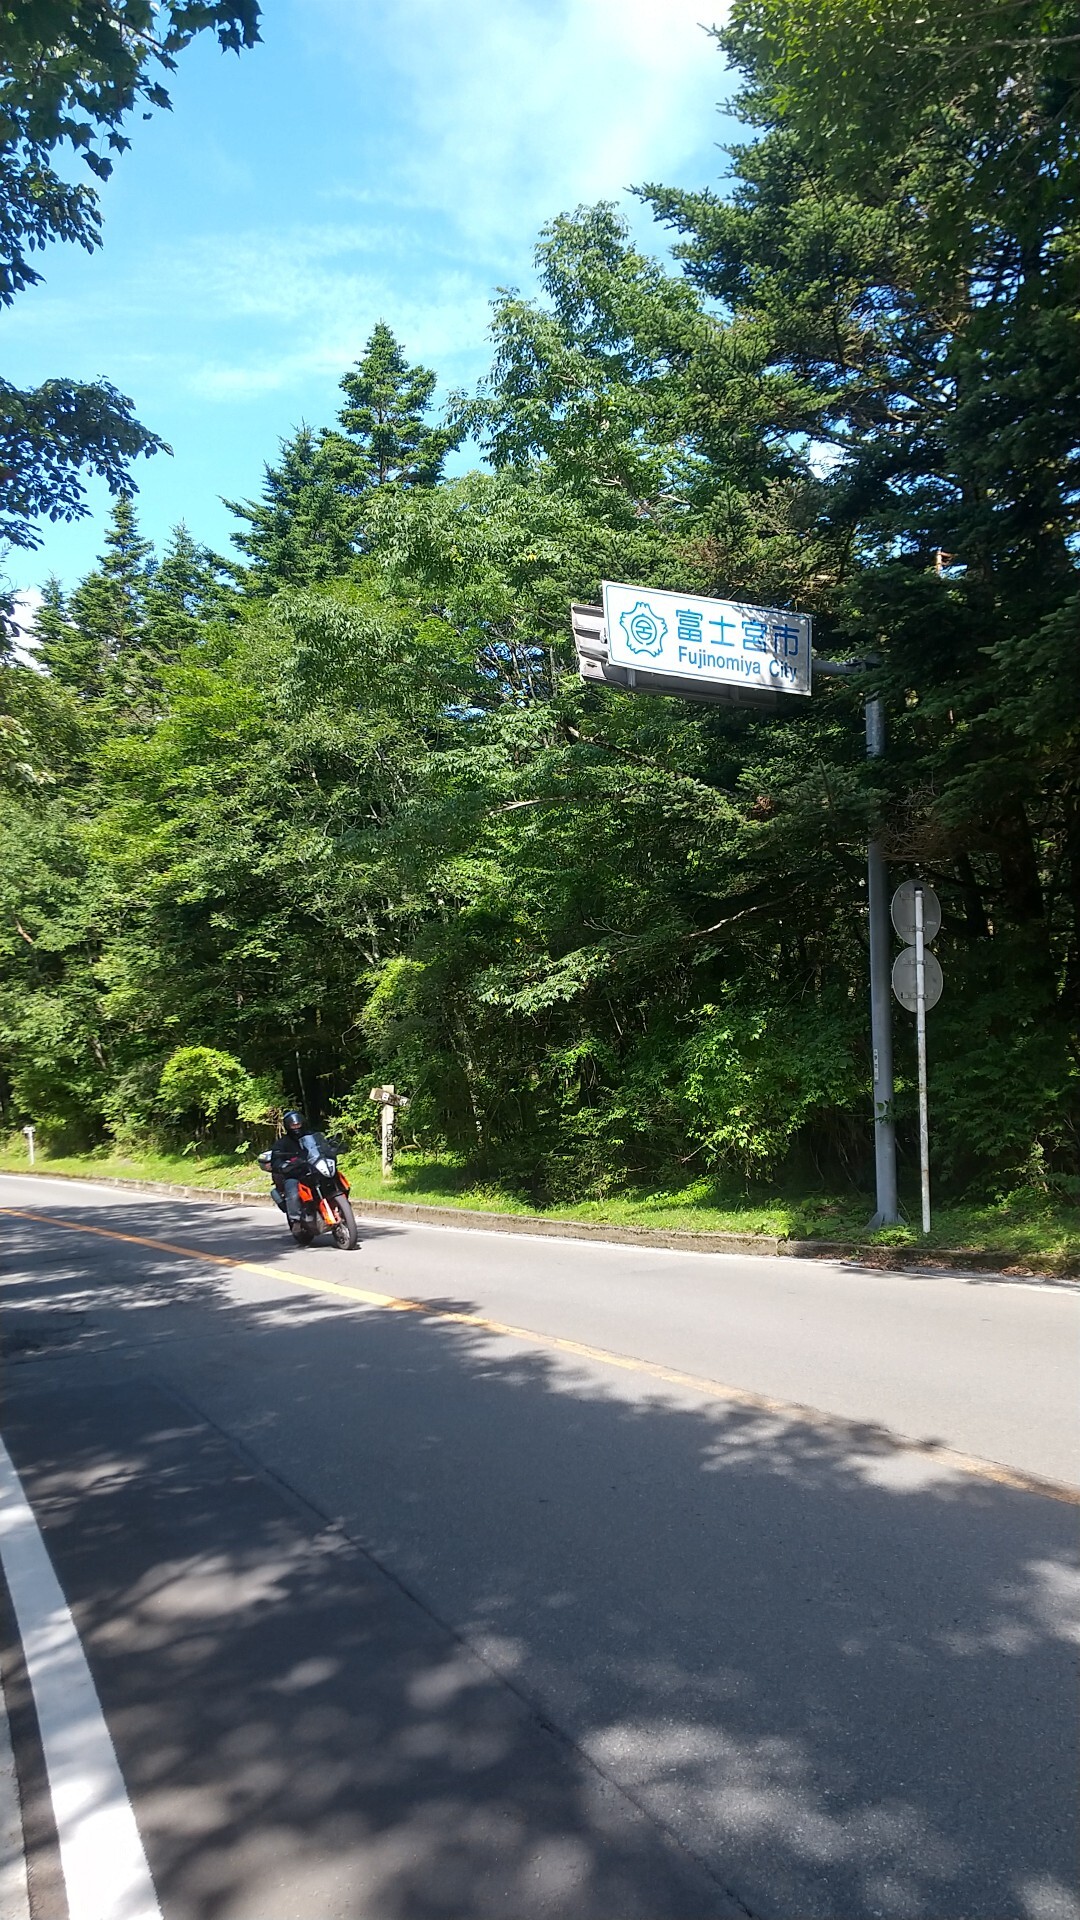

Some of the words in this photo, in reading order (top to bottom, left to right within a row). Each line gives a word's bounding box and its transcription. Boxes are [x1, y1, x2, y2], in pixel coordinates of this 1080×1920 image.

[675, 608, 800, 657] 富士宮市
[678, 646, 761, 676] Fujinomiya
[768, 659, 797, 682] City
